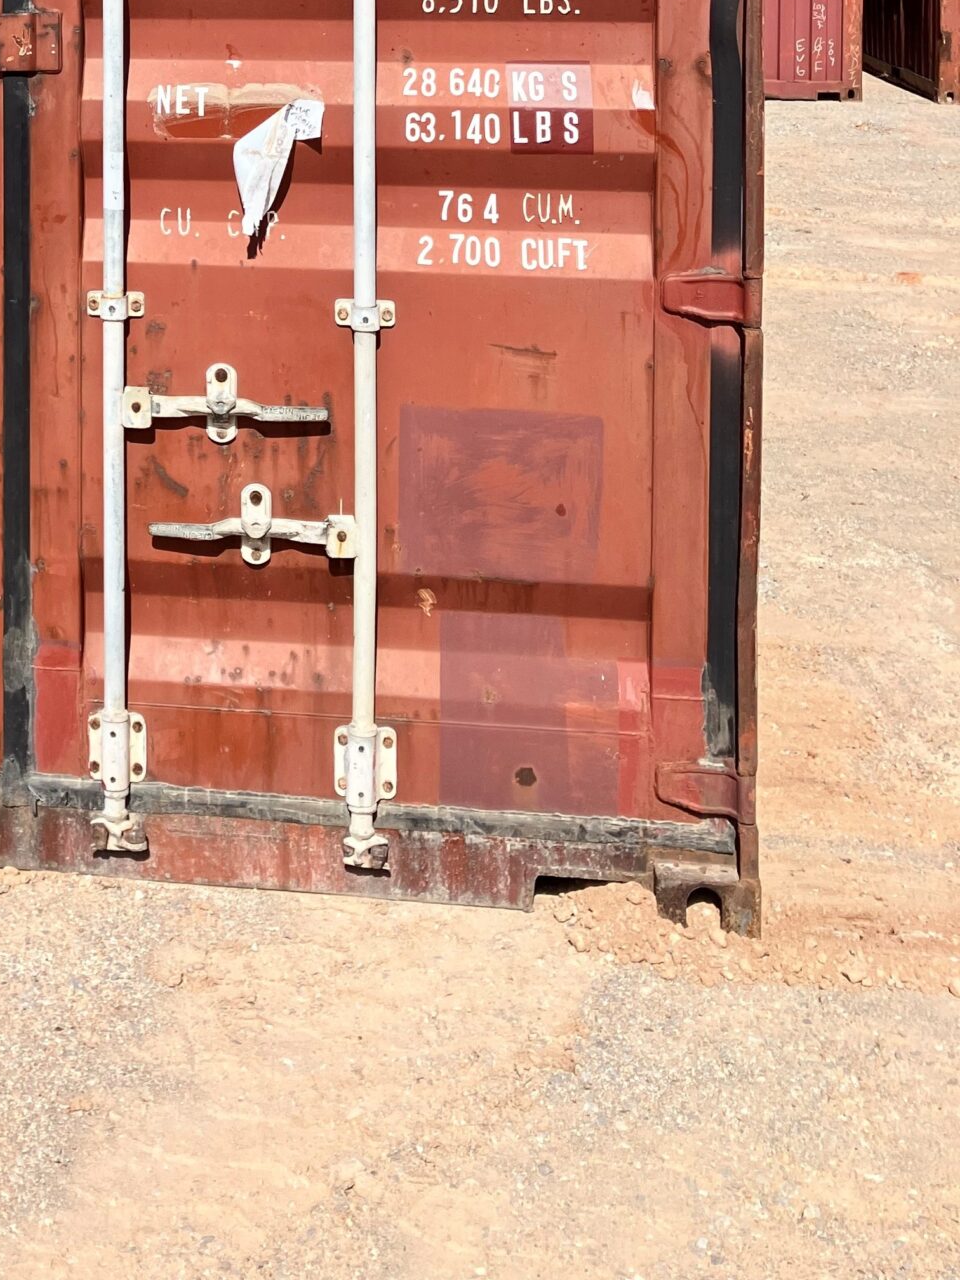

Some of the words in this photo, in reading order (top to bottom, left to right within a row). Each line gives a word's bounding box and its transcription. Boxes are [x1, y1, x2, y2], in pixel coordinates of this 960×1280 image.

[156, 84, 210, 118] NET
[159, 207, 200, 237] CU.
[227, 209, 286, 240] CP.
